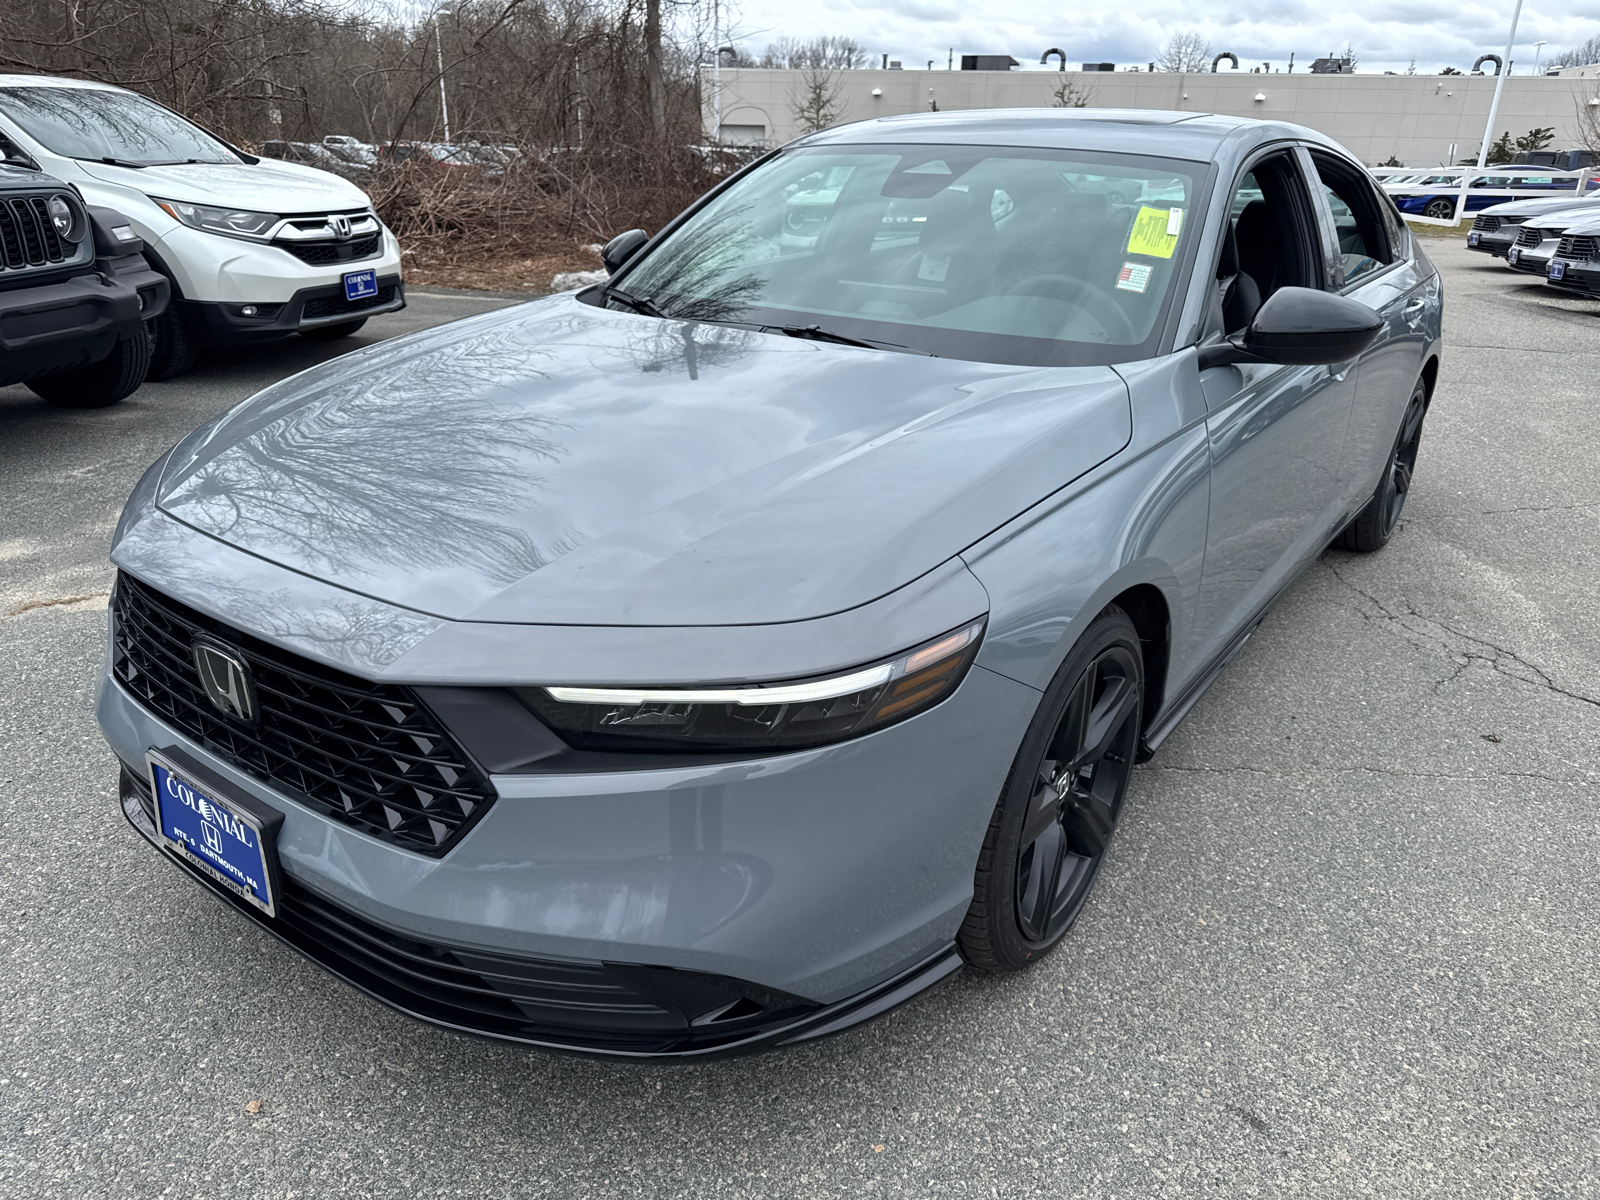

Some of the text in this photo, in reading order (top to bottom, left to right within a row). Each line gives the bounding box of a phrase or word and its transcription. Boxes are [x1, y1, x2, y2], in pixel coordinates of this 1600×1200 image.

[166, 776, 253, 848] COLONIAL
[174, 827, 190, 842] RTE.
[199, 843, 246, 883] DARTMOUTH,
[246, 875, 259, 890] MA
[185, 851, 246, 898] COLONIAL HONDA
